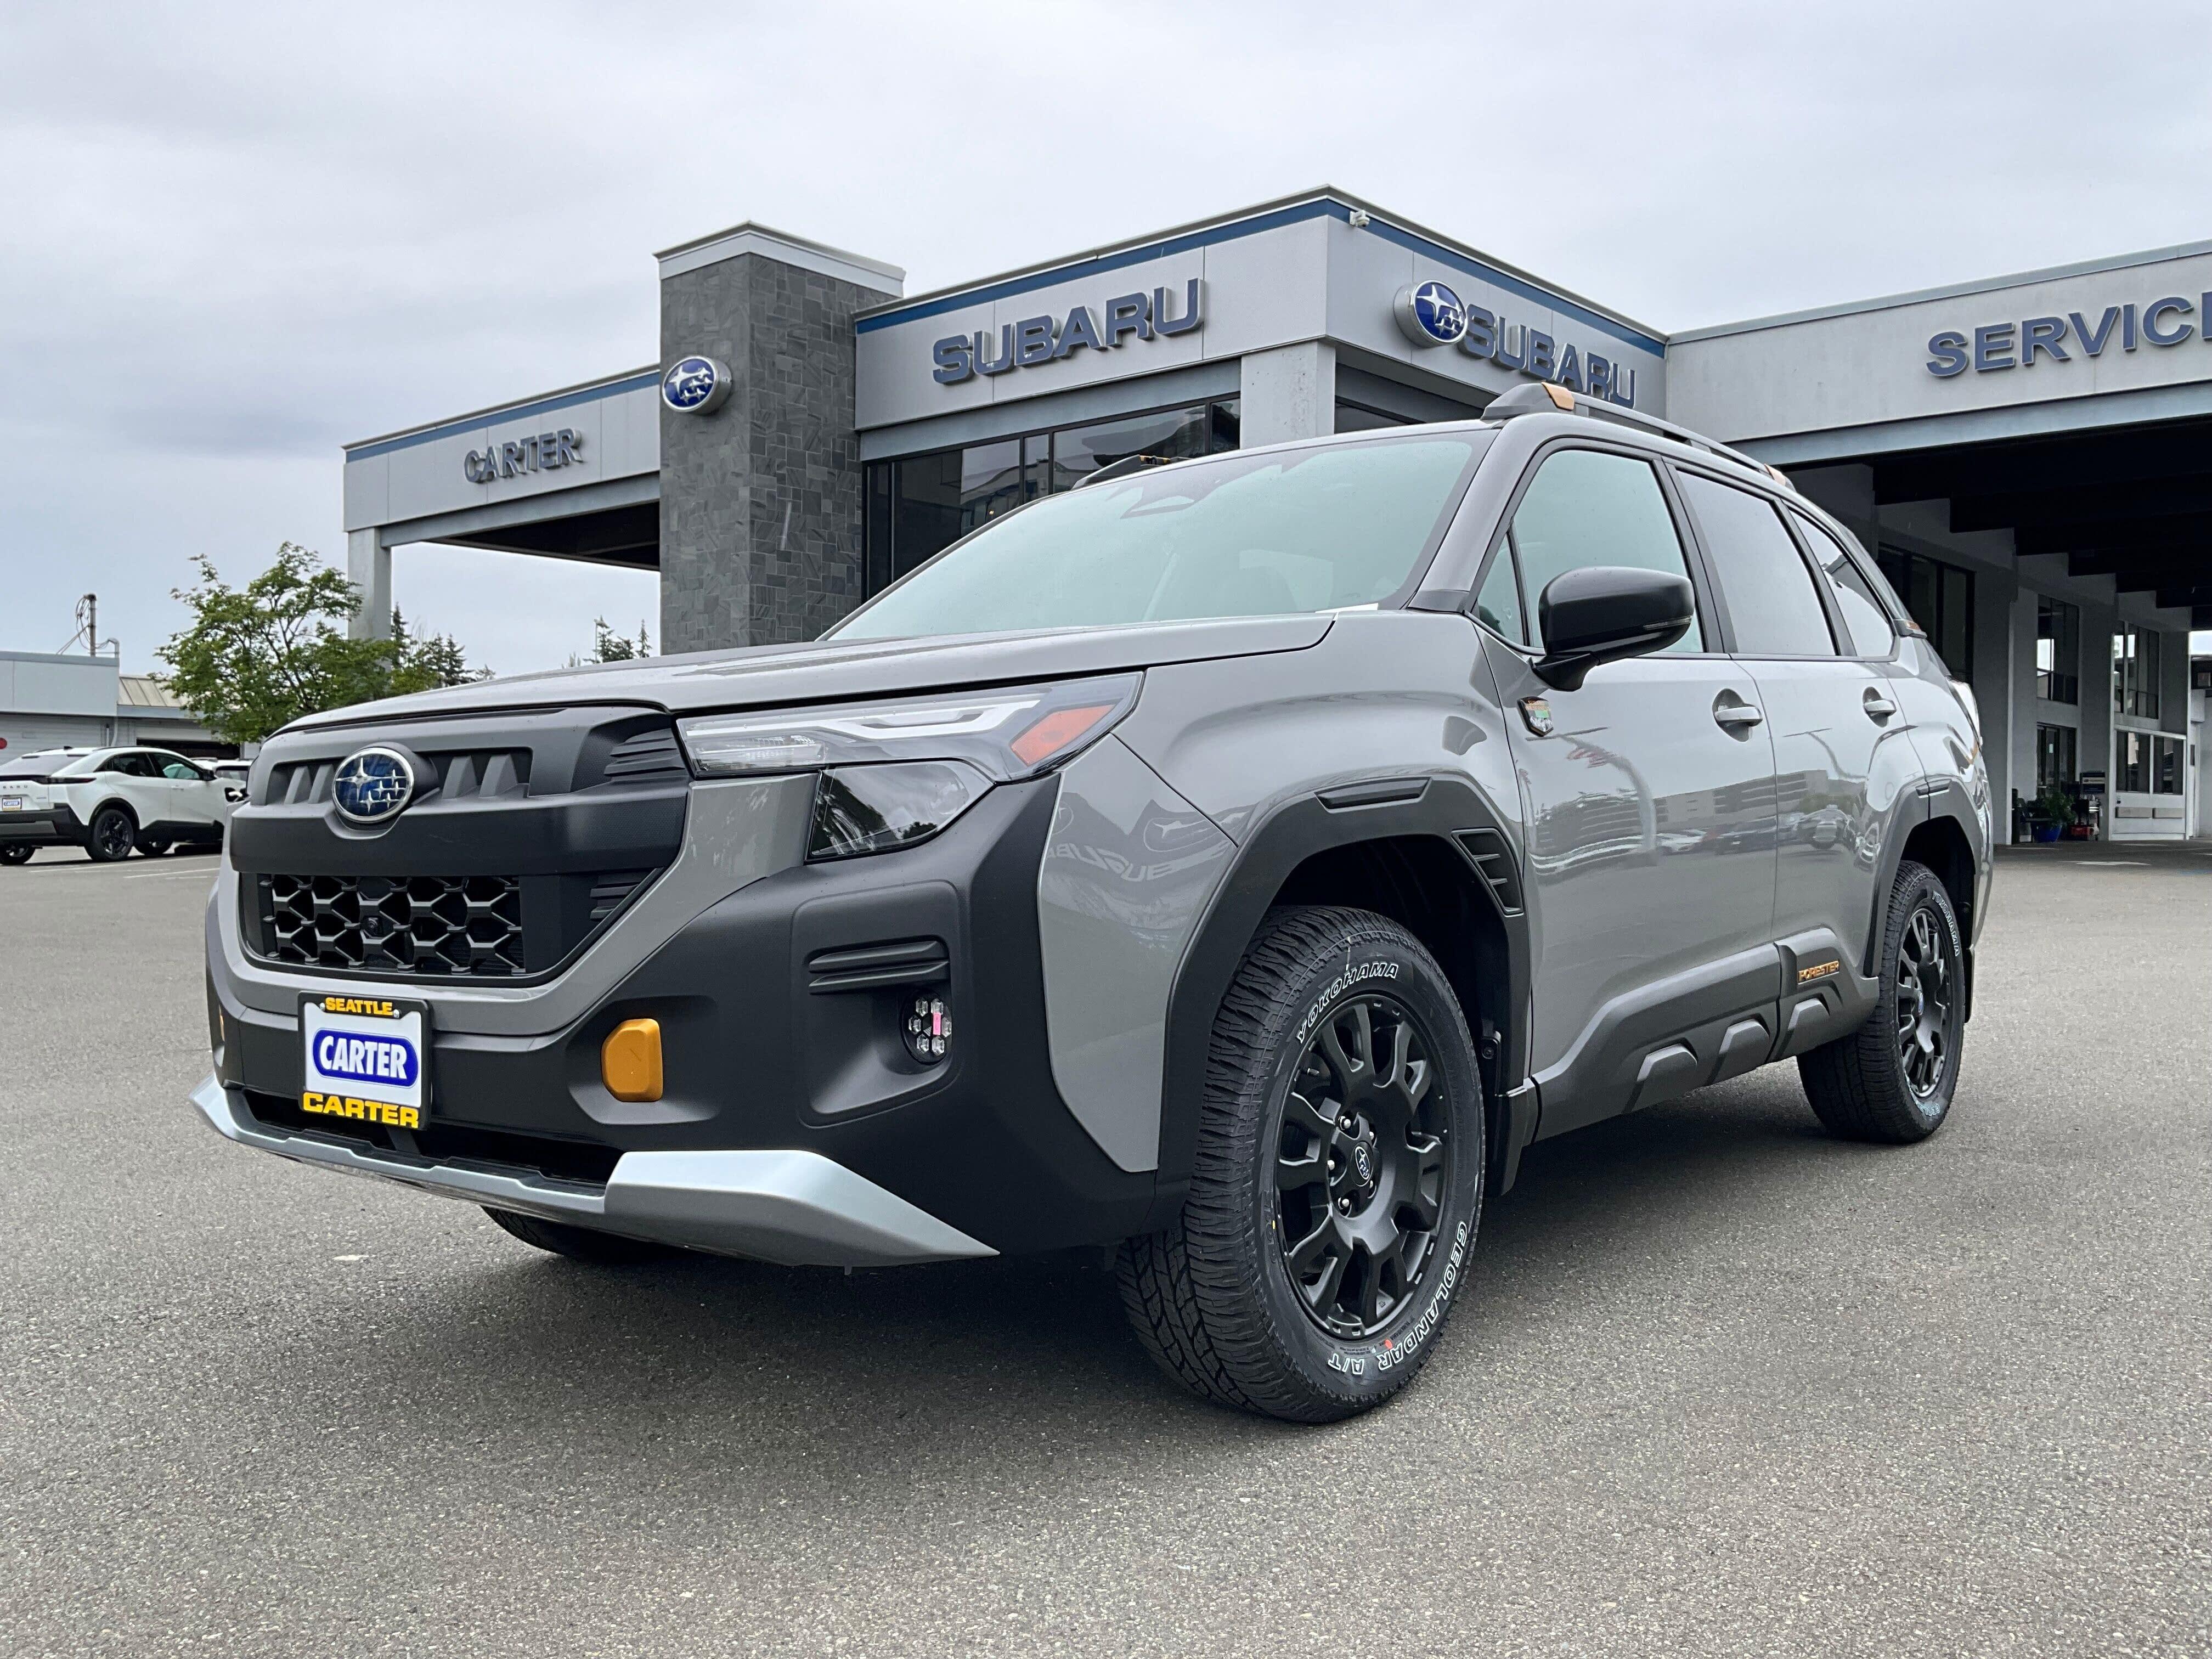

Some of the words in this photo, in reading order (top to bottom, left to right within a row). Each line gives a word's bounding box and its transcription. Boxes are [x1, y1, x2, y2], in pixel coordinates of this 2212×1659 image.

[933, 278, 1205, 385] SUBARU
[1464, 303, 1636, 409] SUBARU
[1926, 291, 2211, 377] SERVIC
[465, 428, 583, 483] CARTER
[1932, 890, 1960, 957] YOKOHAMA
[1798, 960, 1839, 982] FORESTER
[325, 997, 393, 1016] SEATTLE
[1296, 961, 1398, 1043] YOKOHAMA
[320, 1036, 407, 1079] CARTER
[303, 1092, 418, 1128] CARTER
[1376, 1221, 1467, 1370] GEOLANDAR
[1328, 1353, 1364, 1374] A/T
